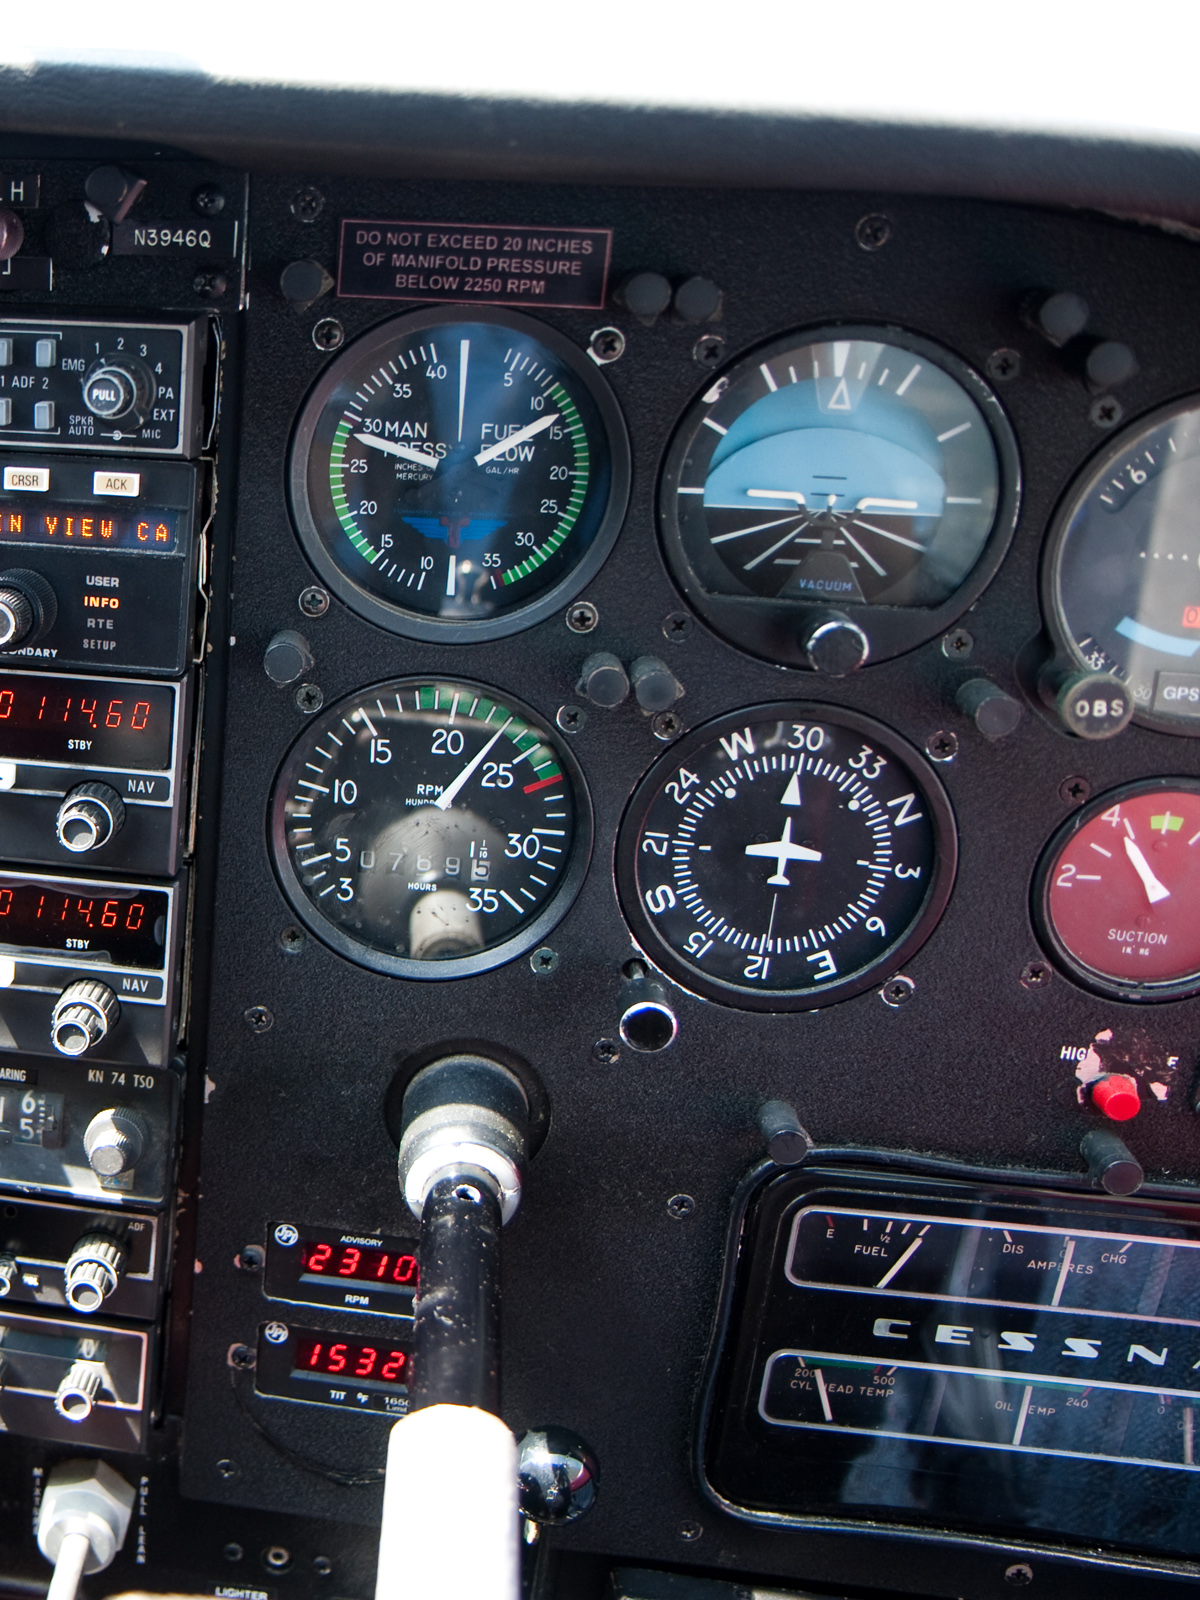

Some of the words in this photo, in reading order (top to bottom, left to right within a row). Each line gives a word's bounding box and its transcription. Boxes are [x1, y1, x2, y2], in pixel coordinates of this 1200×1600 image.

[134, 229, 211, 248] N3946Q
[356, 230, 381, 246] DO
[387, 232, 421, 247] NOT
[427, 234, 498, 250] EXCEED
[503, 237, 522, 250] 20
[527, 239, 592, 255] INCHES
[363, 253, 386, 266] OF
[392, 254, 481, 271] MANIFOLD
[487, 258, 581, 275] PRESSURE
[396, 275, 458, 290] BELOW
[464, 278, 501, 292] 2250
[507, 279, 545, 294] RPM
[62, 359, 85, 371] EMG
[426, 365, 447, 379] 40
[12, 377, 35, 388] ADF
[92, 389, 115, 401] PULL
[158, 387, 174, 399] PA
[69, 415, 94, 425] SPKR
[154, 409, 175, 421] EXT
[69, 425, 94, 436] AUTO
[142, 429, 161, 439] MIC
[385, 422, 428, 438] MAN
[550, 466, 568, 480] 20
[11, 475, 38, 487] CRSR
[106, 478, 126, 490] ACK
[46, 515, 112, 538] VIEW
[137, 522, 167, 541] CA
[86, 575, 119, 587] USER
[799, 579, 852, 591] VACUUM
[84, 596, 119, 608] INFO
[87, 618, 114, 629] RTE
[83, 638, 116, 650] SETUP
[1163, 686, 1199, 700] GPS
[39, 697, 150, 730] 114.60
[1075, 700, 1124, 718] OBS
[432, 729, 464, 755] 20
[788, 724, 824, 751] 30
[68, 740, 92, 750] STBY
[128, 780, 155, 793] NAV
[416, 785, 443, 796] RPM
[408, 883, 436, 891] HOURS
[466, 888, 498, 913] 35
[37, 896, 144, 929] 114.60
[1107, 929, 1168, 944] SUCTION
[88, 1069, 103, 1082] KN
[111, 1072, 126, 1085] 74
[134, 1074, 154, 1088] TSO
[129, 1221, 145, 1232] ADF
[341, 1236, 383, 1247] ADVISORY
[854, 1245, 888, 1257] FUEL
[1003, 1244, 1024, 1254] DIS
[309, 1244, 416, 1282] 2310
[1101, 1254, 1127, 1264] CHG
[345, 1295, 369, 1305] RPM
[873, 1318, 1200, 1370] CESSN
[310, 1344, 405, 1379] 1532
[873, 1376, 895, 1385] 500
[330, 1390, 346, 1399] TIT
[790, 1380, 812, 1389] CYL
[859, 1387, 894, 1397] TEMP
[995, 1401, 1014, 1411] OIL
[1066, 1398, 1088, 1409] 240
